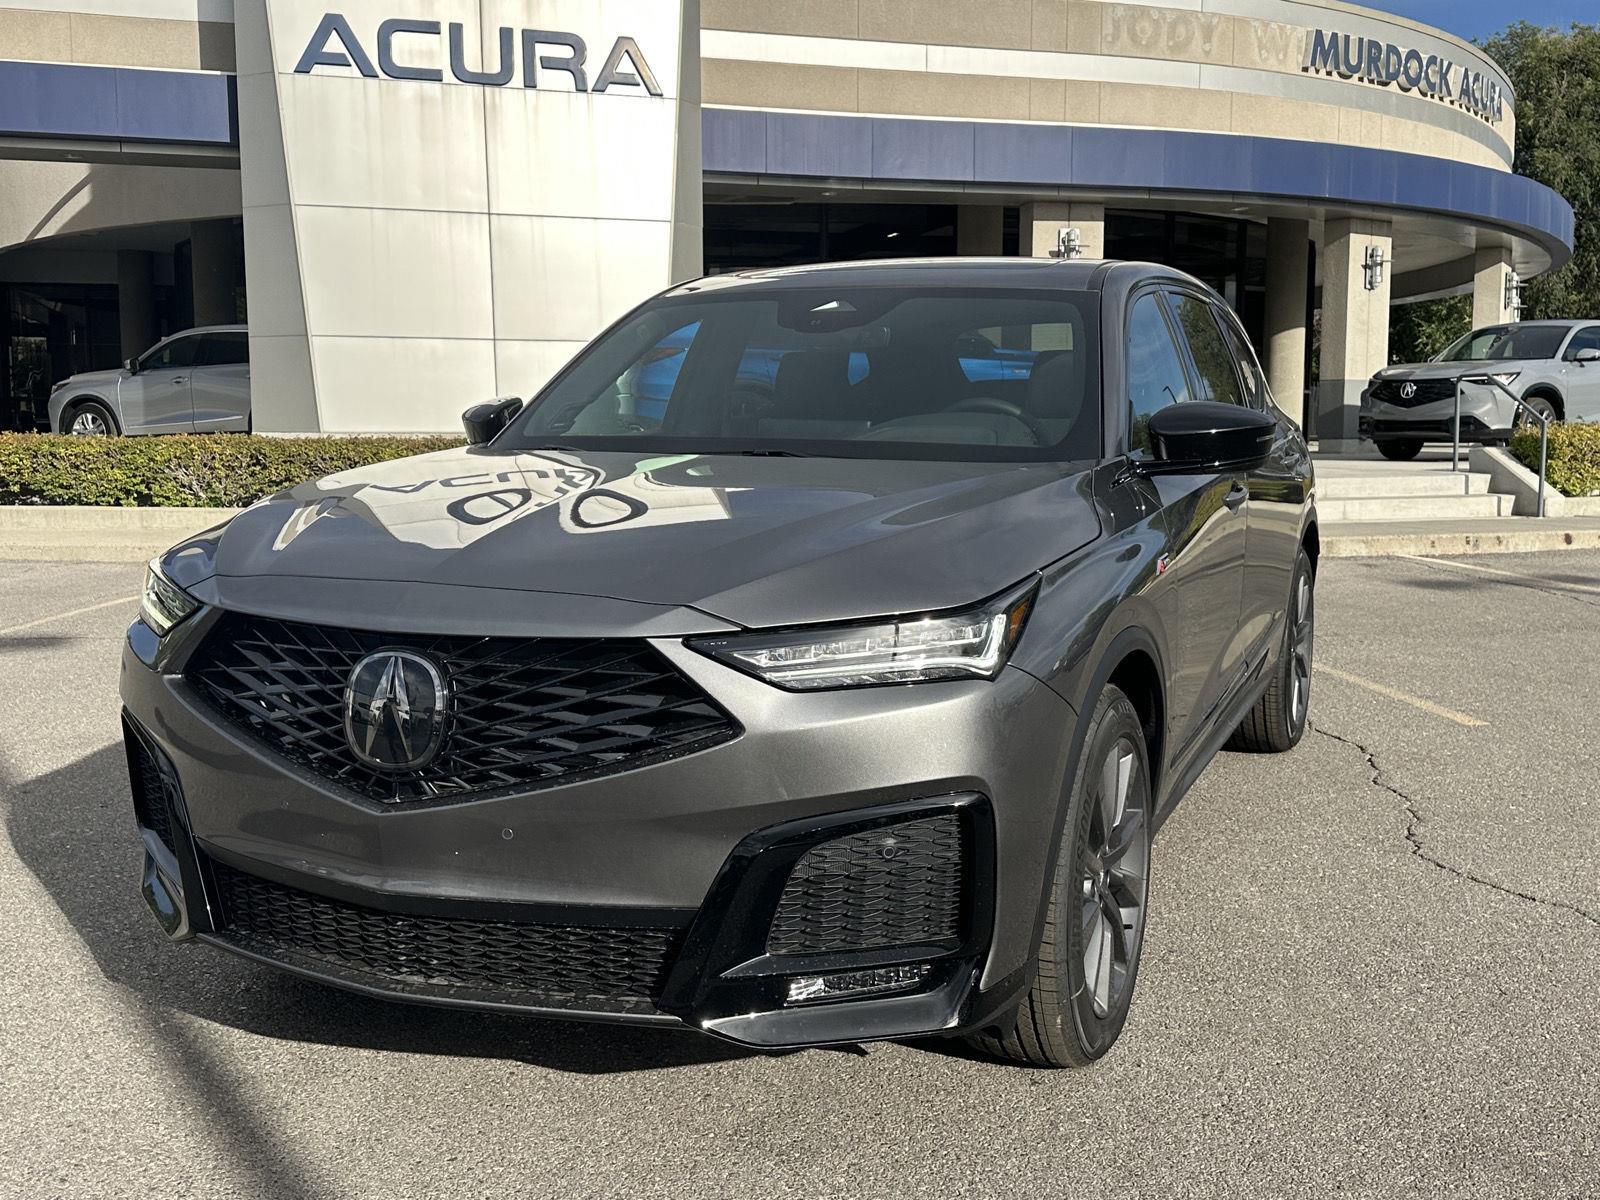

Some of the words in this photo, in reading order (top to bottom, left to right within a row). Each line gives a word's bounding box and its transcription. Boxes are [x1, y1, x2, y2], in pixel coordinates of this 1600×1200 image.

[294, 13, 663, 97] ACURA
[1310, 28, 1453, 98] MURDOCK
[1459, 67, 1503, 121] ACURA
